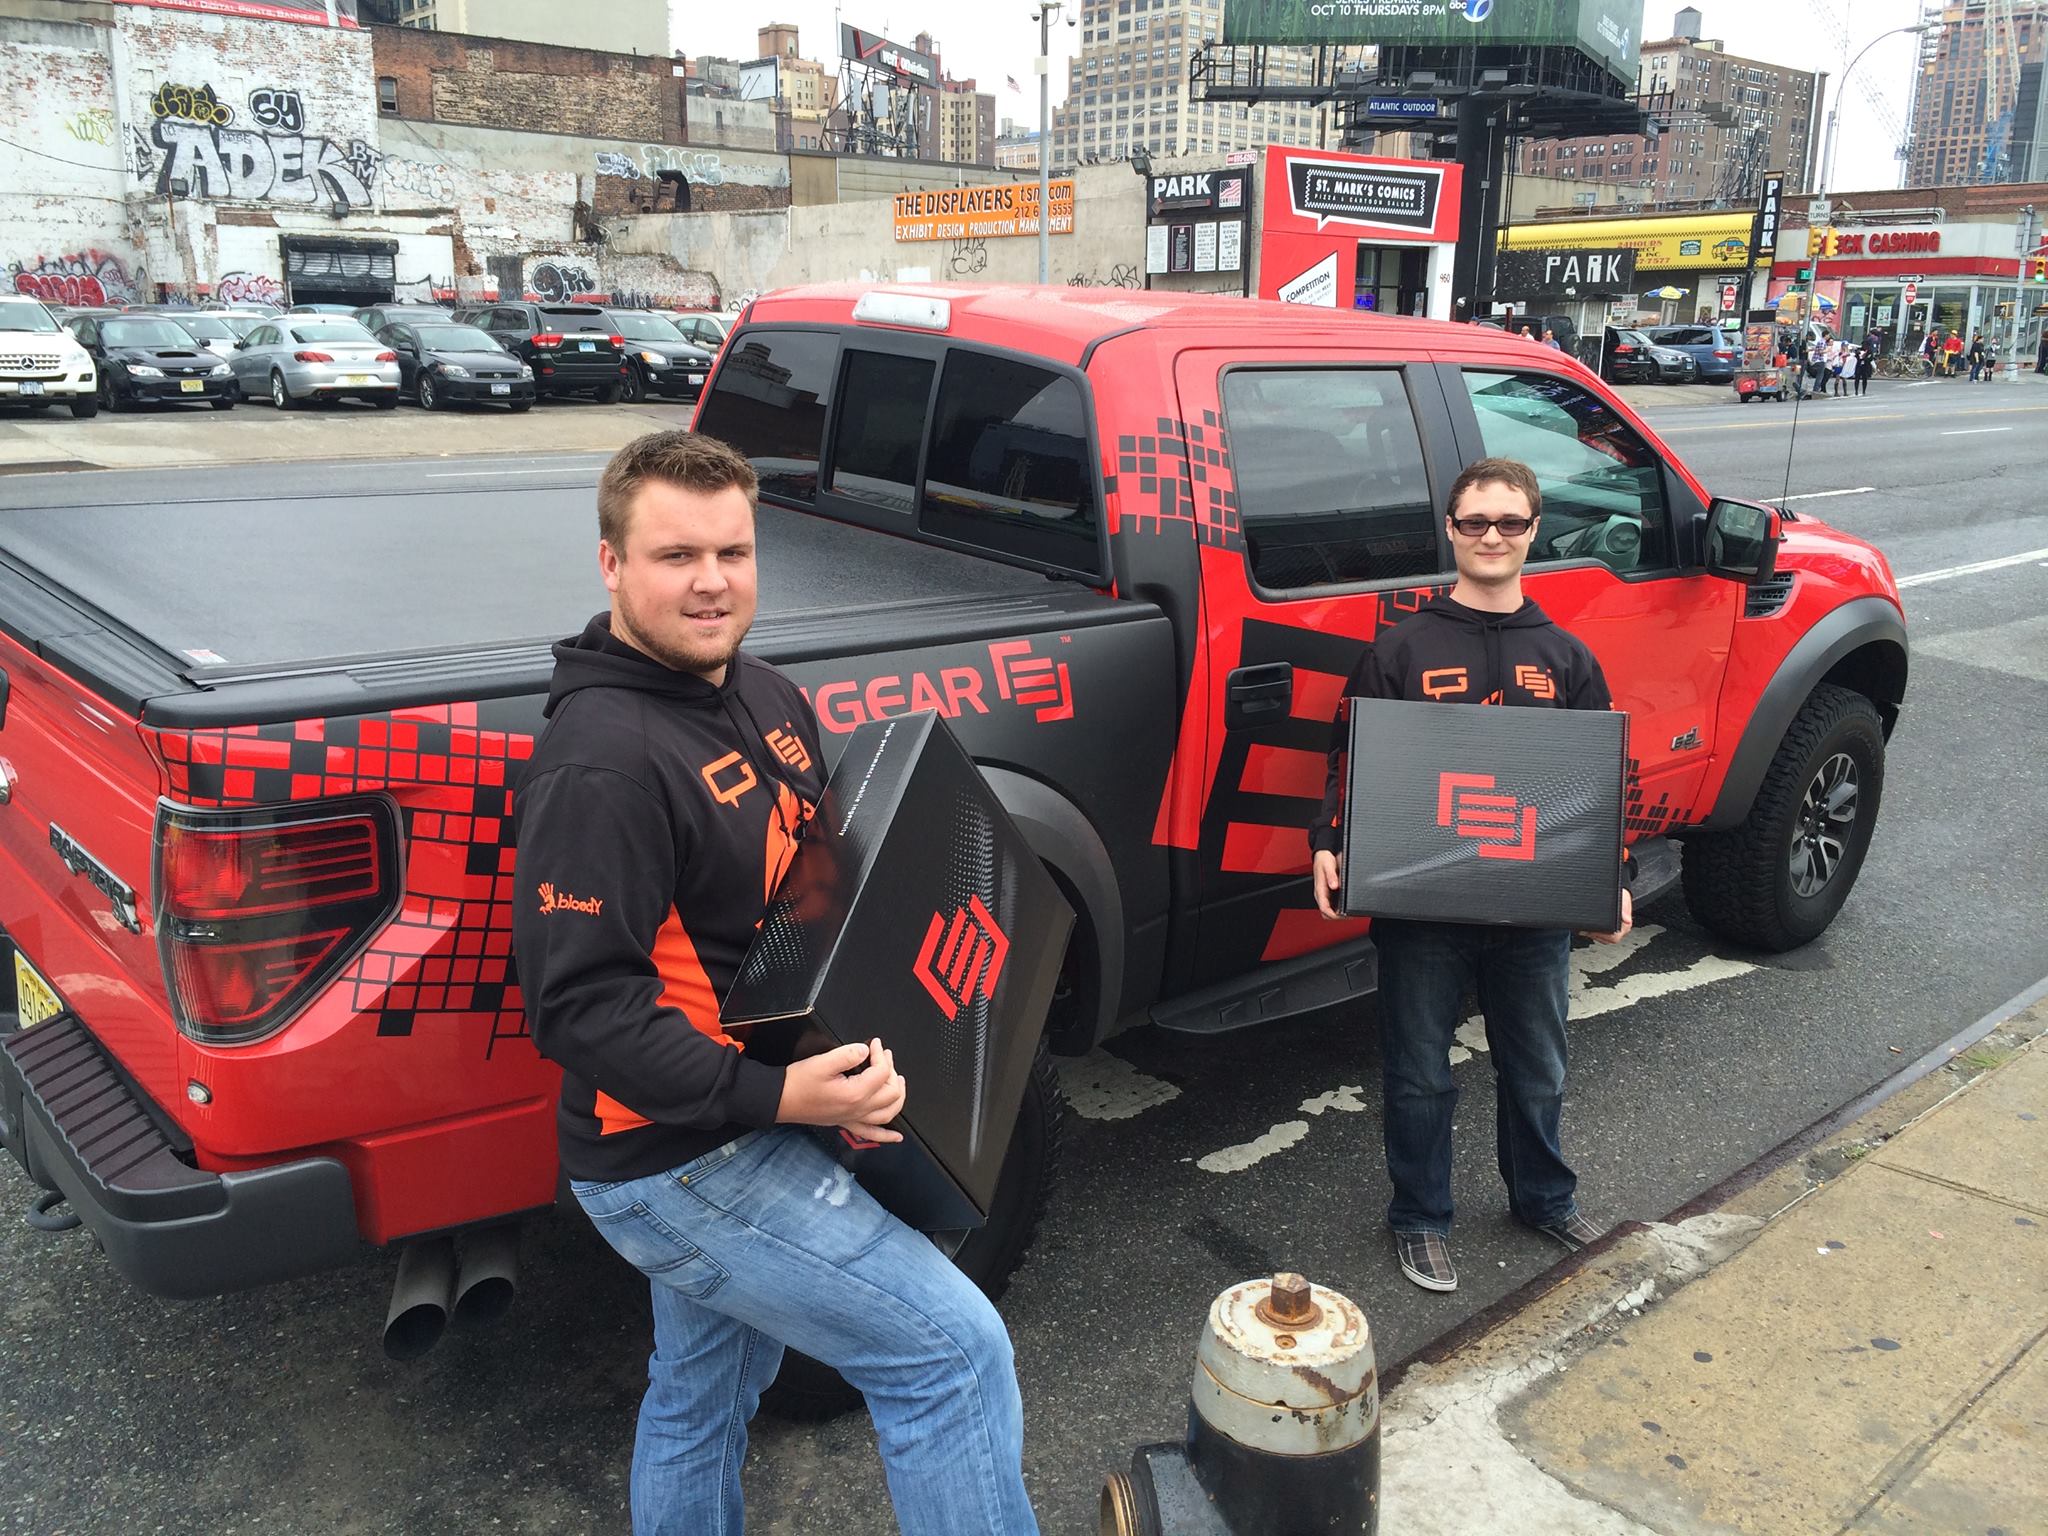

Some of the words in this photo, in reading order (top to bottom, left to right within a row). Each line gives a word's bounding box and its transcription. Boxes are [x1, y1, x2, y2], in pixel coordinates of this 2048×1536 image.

[1311, 5, 1335, 16] OCT
[1340, 5, 1351, 16] 10
[1354, 5, 1419, 16] THURSDAYS
[1422, 5, 1446, 16] 8PM
[1369, 102, 1400, 111] ATLANTIC
[1402, 103, 1435, 112] OUTDOOR
[1154, 174, 1211, 198] PARK
[1316, 179, 1330, 193] ST.
[1335, 181, 1374, 197] MARK'S
[1378, 186, 1415, 200] COMICS
[896, 195, 922, 218] THE
[926, 188, 1013, 215] DISPLAYERS
[1053, 203, 1072, 216] 5555
[1315, 193, 1336, 201] PIZZA
[1388, 200, 1414, 208] SALOON
[1015, 206, 1030, 219] 212
[1761, 180, 1778, 247] PARK
[896, 224, 934, 240] EXHIBIT
[937, 223, 964, 237] DESIGN
[969, 220, 1016, 236] PRODUCTION
[1019, 217, 1072, 233] MANAMENT
[1869, 231, 1940, 254] CASHING
[1545, 254, 1621, 284] PARK
[1286, 271, 1331, 303] COMPETITION
[864, 721, 897, 779] High-performance
[854, 780, 869, 802] mobile
[837, 802, 859, 837] ingenuity
[49, 820, 143, 935] RAPTOR
